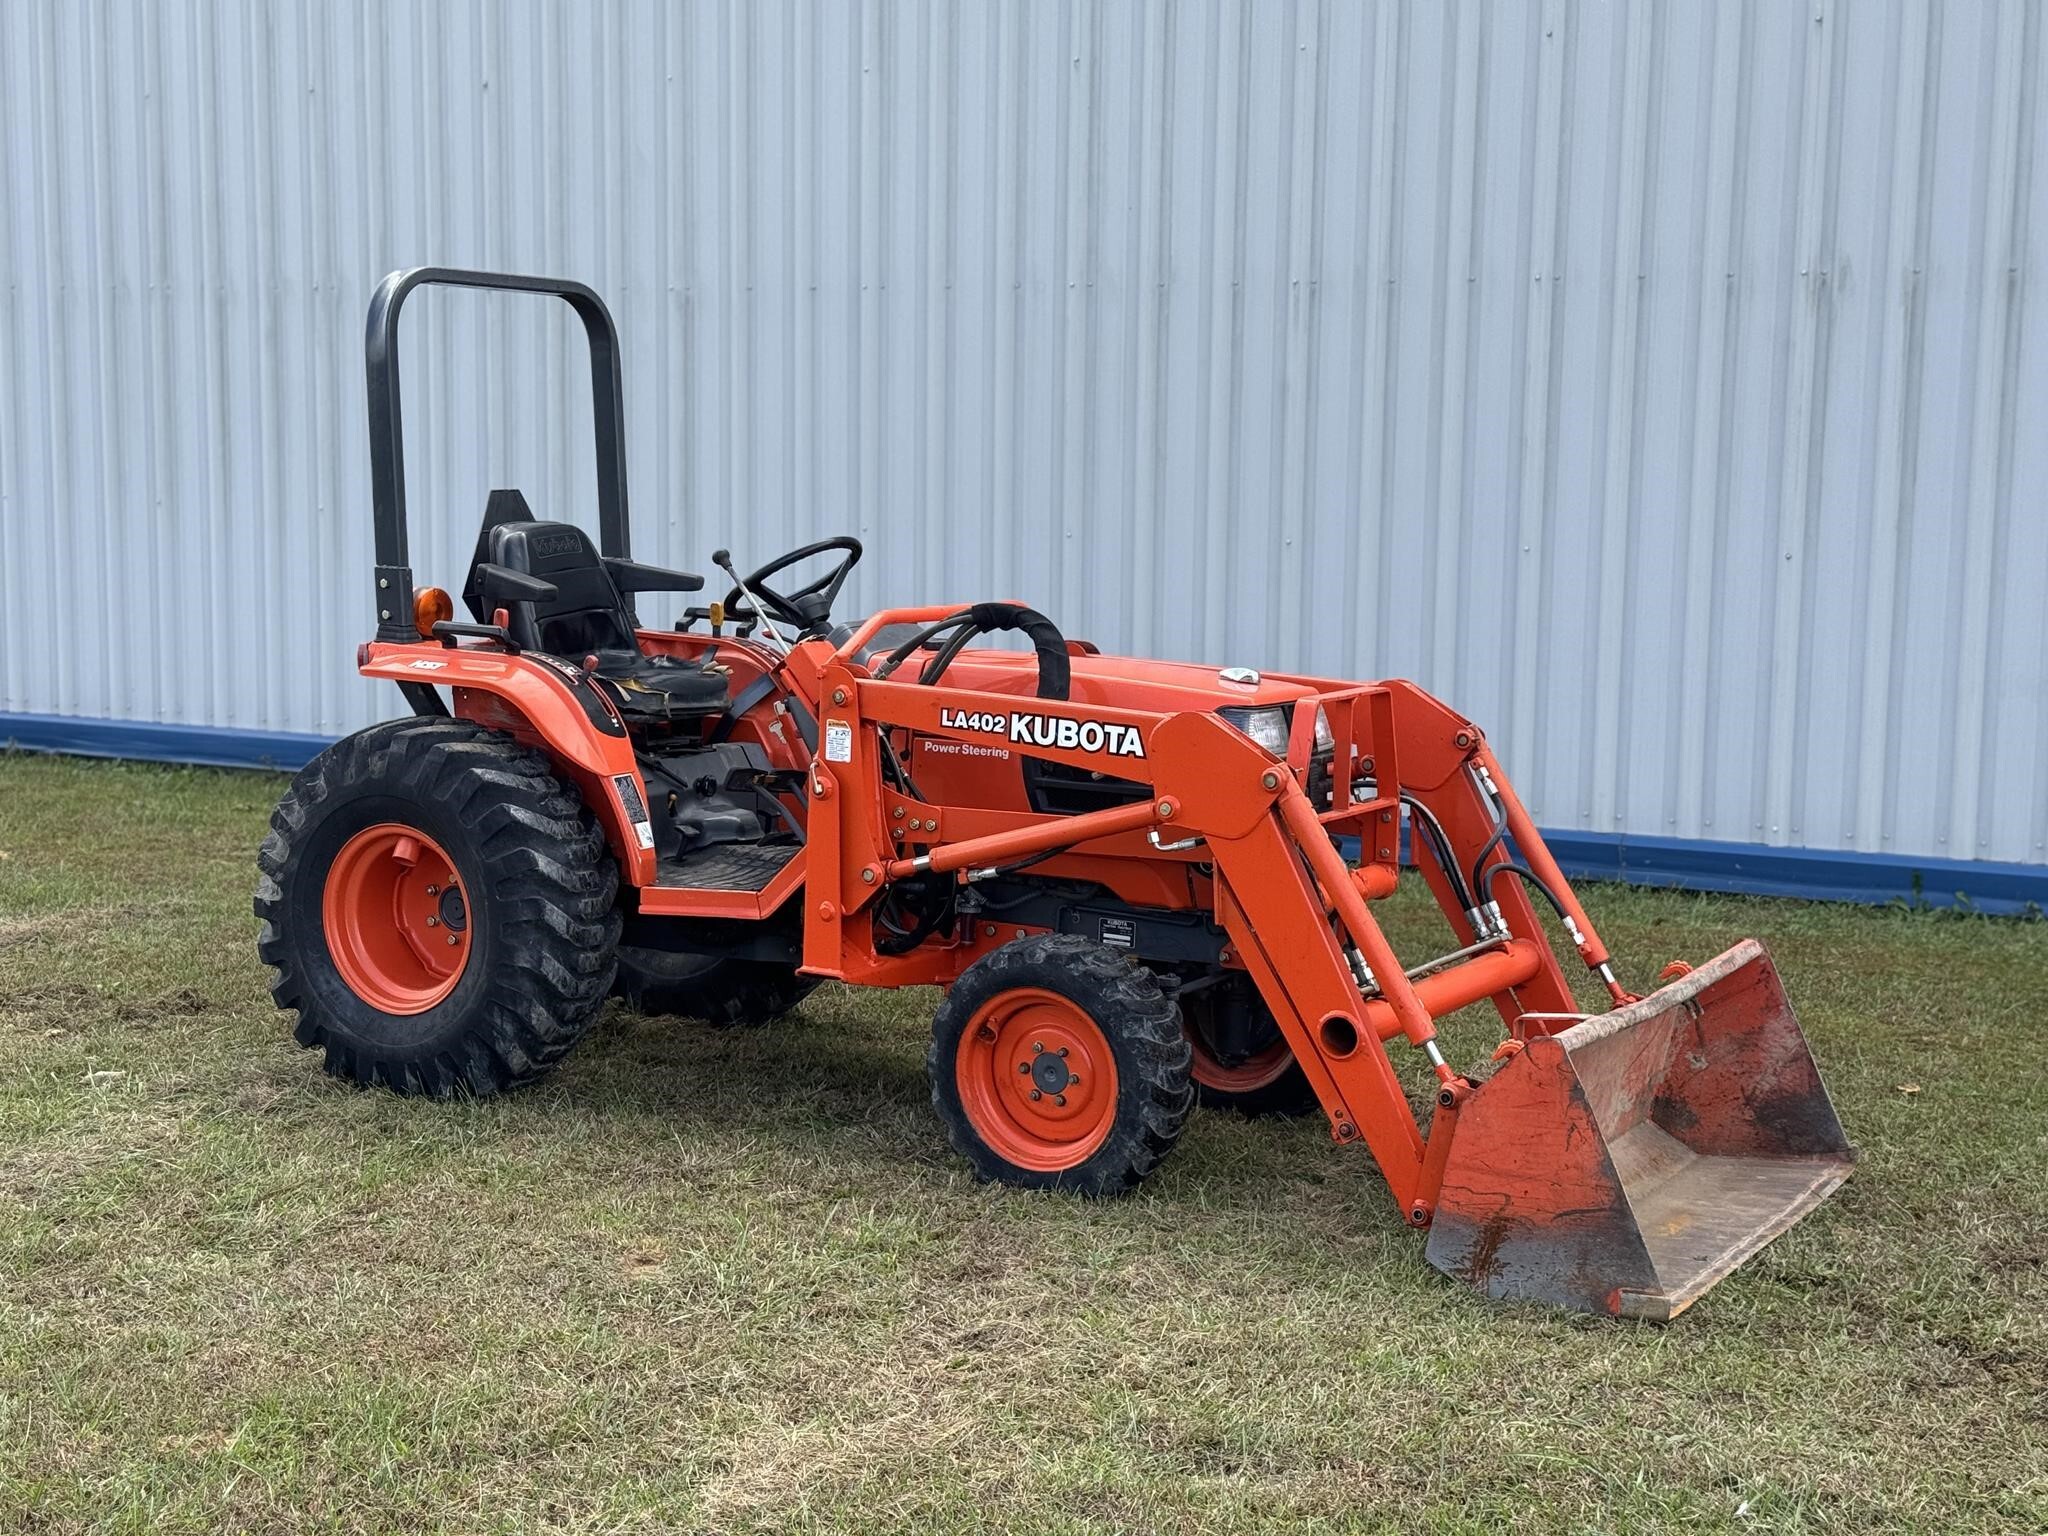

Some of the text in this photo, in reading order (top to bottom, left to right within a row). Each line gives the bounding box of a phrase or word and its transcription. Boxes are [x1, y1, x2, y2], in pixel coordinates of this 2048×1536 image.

[941, 709, 1145, 757] LA402 KUBOTA
[924, 741, 1009, 760] Power Steering
